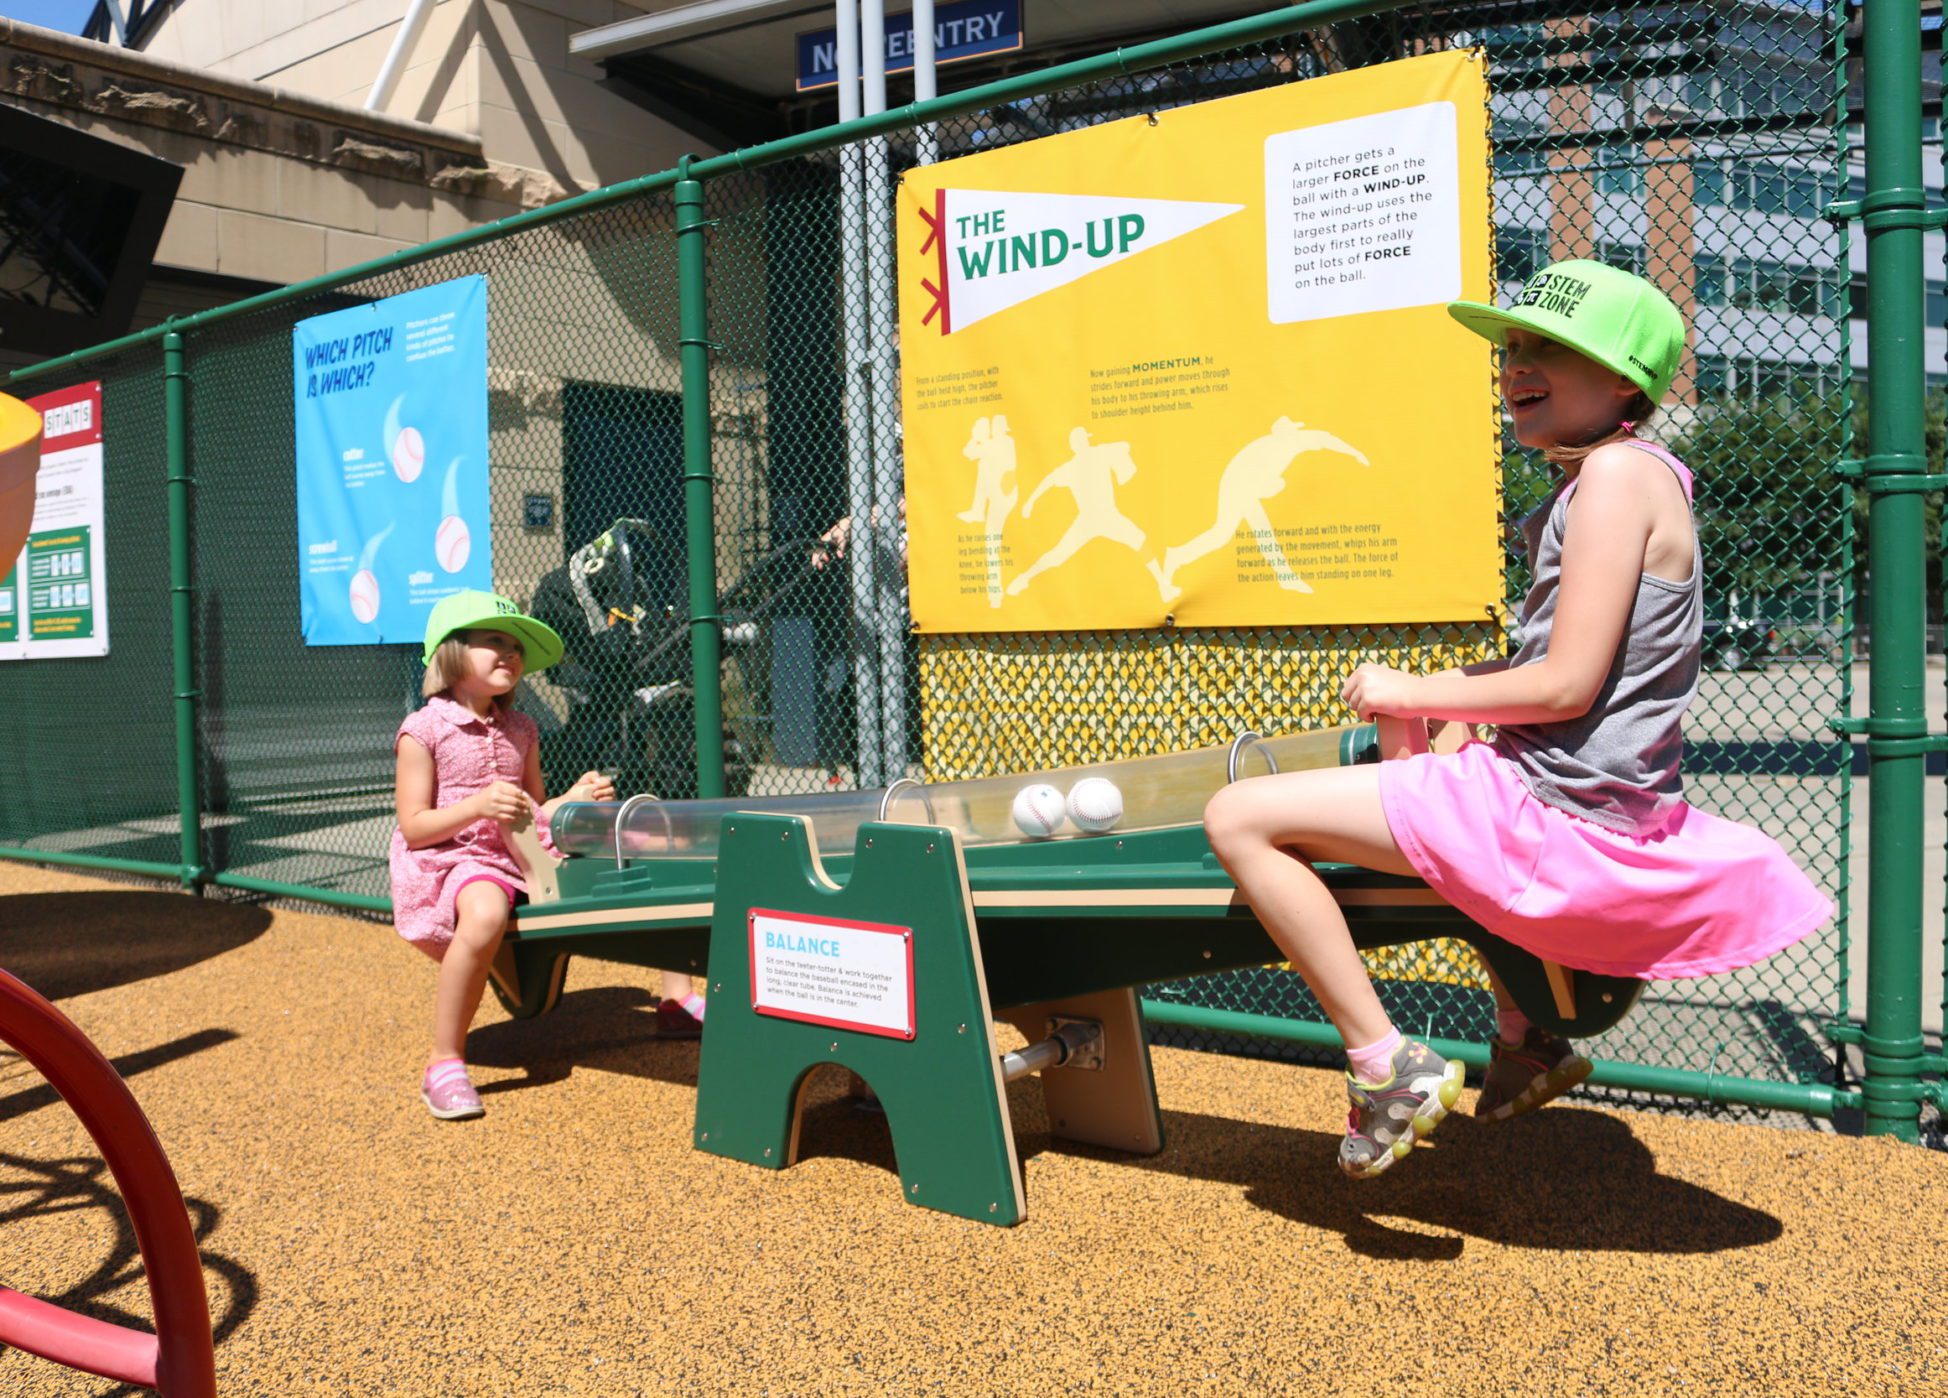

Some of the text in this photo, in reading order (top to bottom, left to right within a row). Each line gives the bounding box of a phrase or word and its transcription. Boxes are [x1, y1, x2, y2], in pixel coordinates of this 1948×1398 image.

[812, 12, 1004, 73] N ENTRY
[1292, 147, 1394, 172] A pitcher gets a
[1293, 157, 1425, 189] larger FORCE on the
[1293, 174, 1429, 206] ball with a WIND-UP.
[1294, 192, 1432, 222] The wind-up uses the
[956, 209, 1005, 239] THE
[1294, 211, 1417, 239] largest parts of the
[956, 213, 1145, 280] WIND-UP
[1294, 229, 1413, 255] body first to really
[1295, 246, 1411, 273] put lots of FORCE
[1295, 270, 1366, 288] on the ball.
[1549, 275, 1592, 300] STEM
[1539, 291, 1579, 318] ZONE
[306, 338, 349, 369] WHICH
[352, 326, 393, 360] PITCH
[307, 361, 375, 398] IS WHICH?
[1091, 369, 1104, 378] Now
[1106, 366, 1130, 377] gaining
[1205, 356, 1213, 364] he
[1091, 368, 1230, 392] strides forward and power moves through
[1091, 397, 1100, 405] his
[1102, 394, 1118, 405] body
[1120, 394, 1126, 402] to
[1129, 392, 1138, 401] his
[1140, 389, 1169, 400] throwing
[1190, 385, 1210, 394] which
[1212, 383, 1228, 392] rises
[46, 406, 89, 431] STATS
[1092, 411, 1098, 419] to
[1100, 406, 1128, 418] shoulder
[1130, 405, 1150, 416] height
[1153, 402, 1176, 412] behind
[1236, 524, 1381, 539] He rotates forward and with the energy
[1237, 543, 1272, 554] generated
[1275, 542, 1283, 553] by
[1286, 542, 1297, 551] the
[1344, 539, 1366, 549] whips
[1369, 538, 1380, 547] his
[1382, 538, 1397, 546] arm
[1237, 558, 1265, 568] forward
[1268, 558, 1276, 566] as
[1278, 557, 1286, 566] he
[1288, 555, 1318, 566] releases
[1320, 555, 1332, 564] the
[1354, 553, 1366, 563] The
[1369, 552, 1388, 562] force
[1390, 552, 1398, 560] of
[1238, 574, 1249, 582] the
[1252, 572, 1274, 582] action
[1276, 571, 1299, 581] leaves
[1301, 571, 1314, 580] him
[1317, 569, 1349, 580] standing
[1351, 569, 1361, 577] on
[1363, 568, 1376, 577] one
[766, 932, 840, 957] BALANCE
[774, 969, 798, 978] balance
[800, 971, 810, 979] the
[812, 974, 838, 984] baseball
[840, 979, 867, 989] encased
[877, 983, 888, 991] the
[797, 962, 836, 974] teeter-totter
[845, 969, 860, 977] work
[863, 971, 892, 982] together
[797, 991, 808, 999] ball
[824, 996, 835, 1004] the
[818, 985, 843, 995] Balance
[852, 990, 882, 1001] achieved
